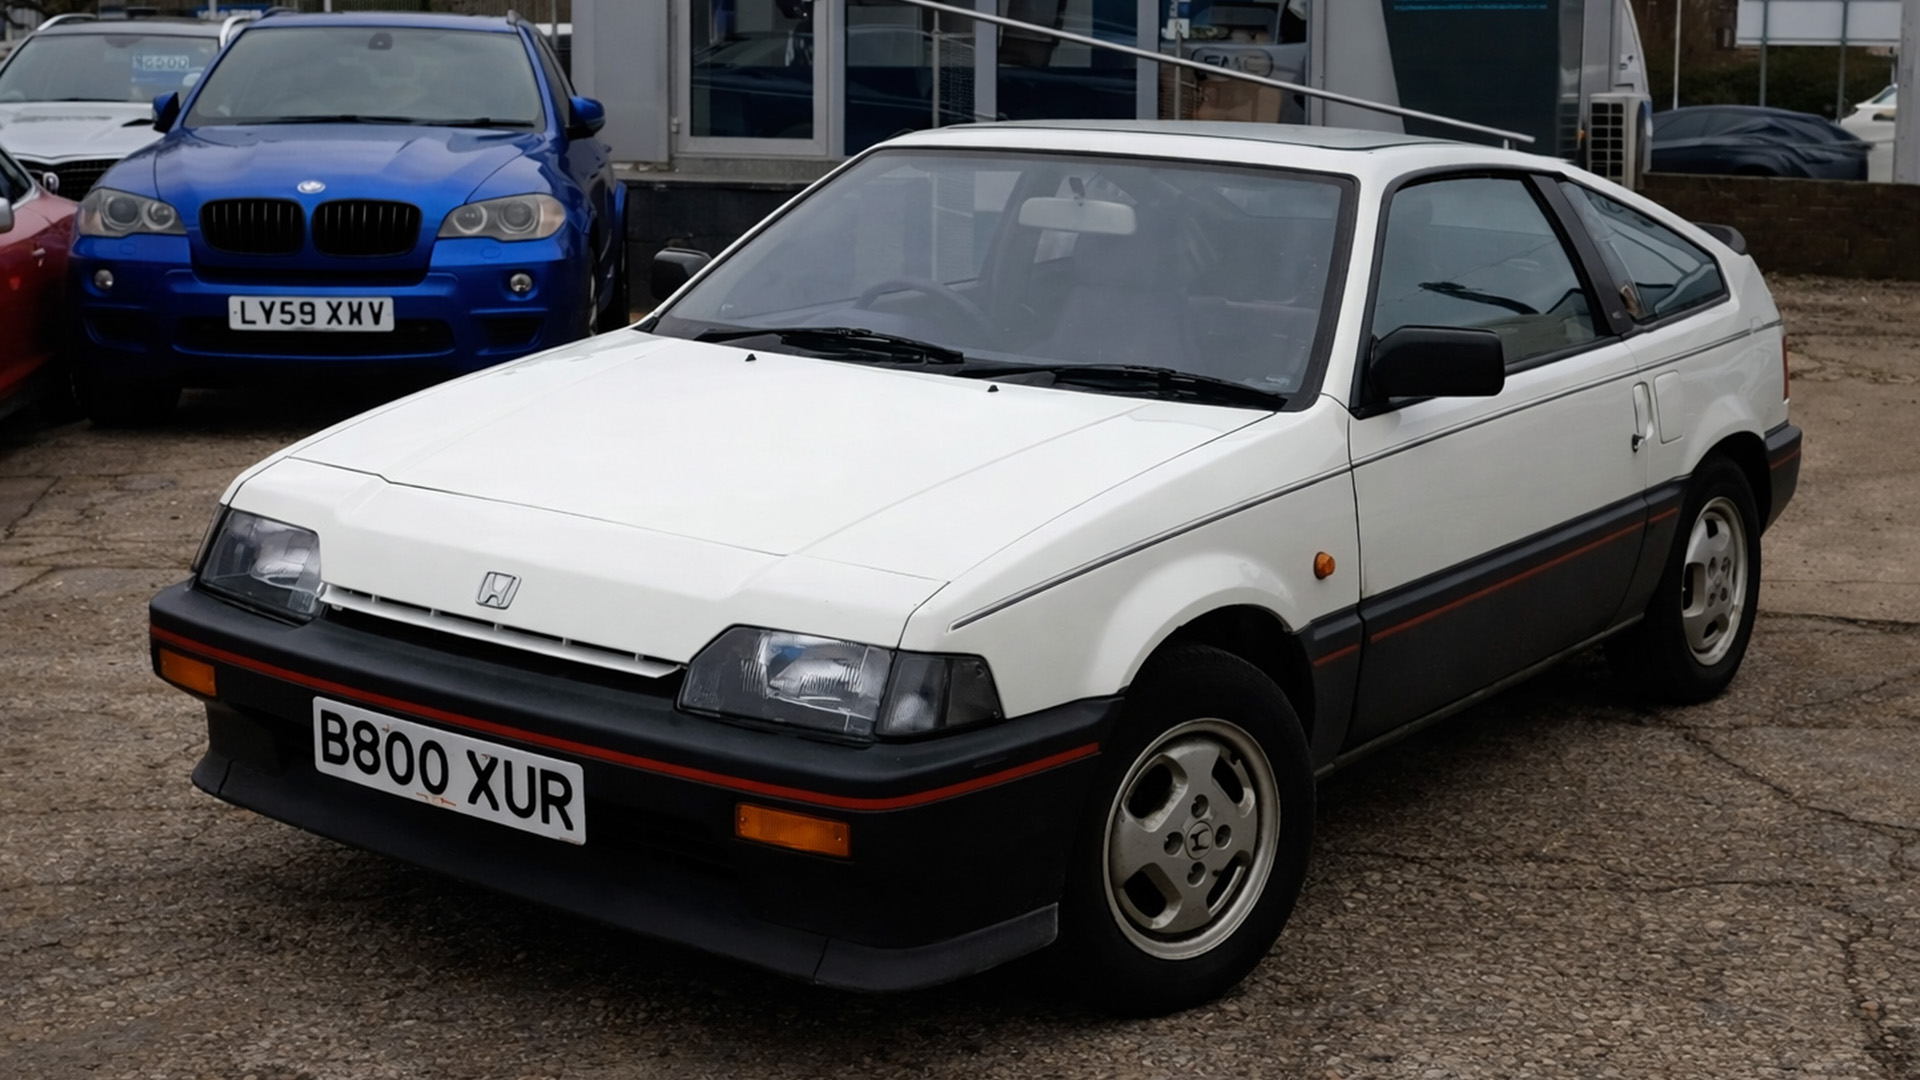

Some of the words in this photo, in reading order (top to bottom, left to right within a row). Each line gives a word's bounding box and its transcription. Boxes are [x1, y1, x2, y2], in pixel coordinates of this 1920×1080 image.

[240, 301, 315, 325] LY59
[321, 709, 449, 795] B800
[466, 749, 574, 831] XUR
